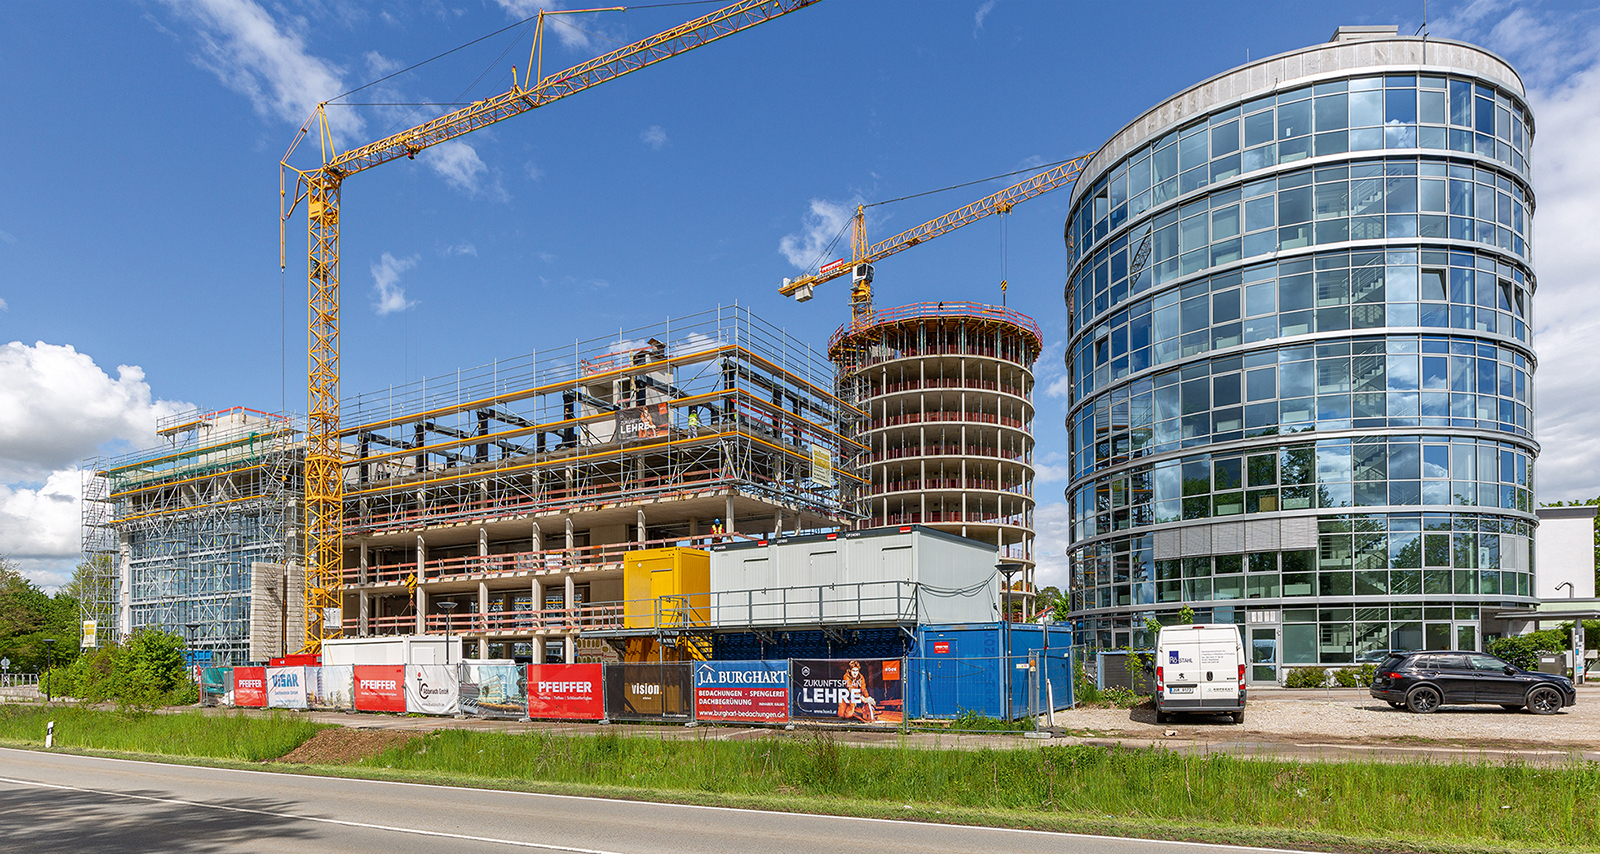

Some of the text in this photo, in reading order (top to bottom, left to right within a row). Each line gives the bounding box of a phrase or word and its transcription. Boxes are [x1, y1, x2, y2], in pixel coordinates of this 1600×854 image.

[620, 422, 650, 434] LEHRE
[697, 670, 787, 686] J.A. BURGHART
[803, 679, 862, 687] ZUKUNFTSPLAN
[360, 680, 396, 690] PFEIFFER
[538, 682, 592, 693] PFEIFFER
[802, 687, 862, 704] LEHRE
[698, 698, 752, 706] DACHBEGRÜNUNG
